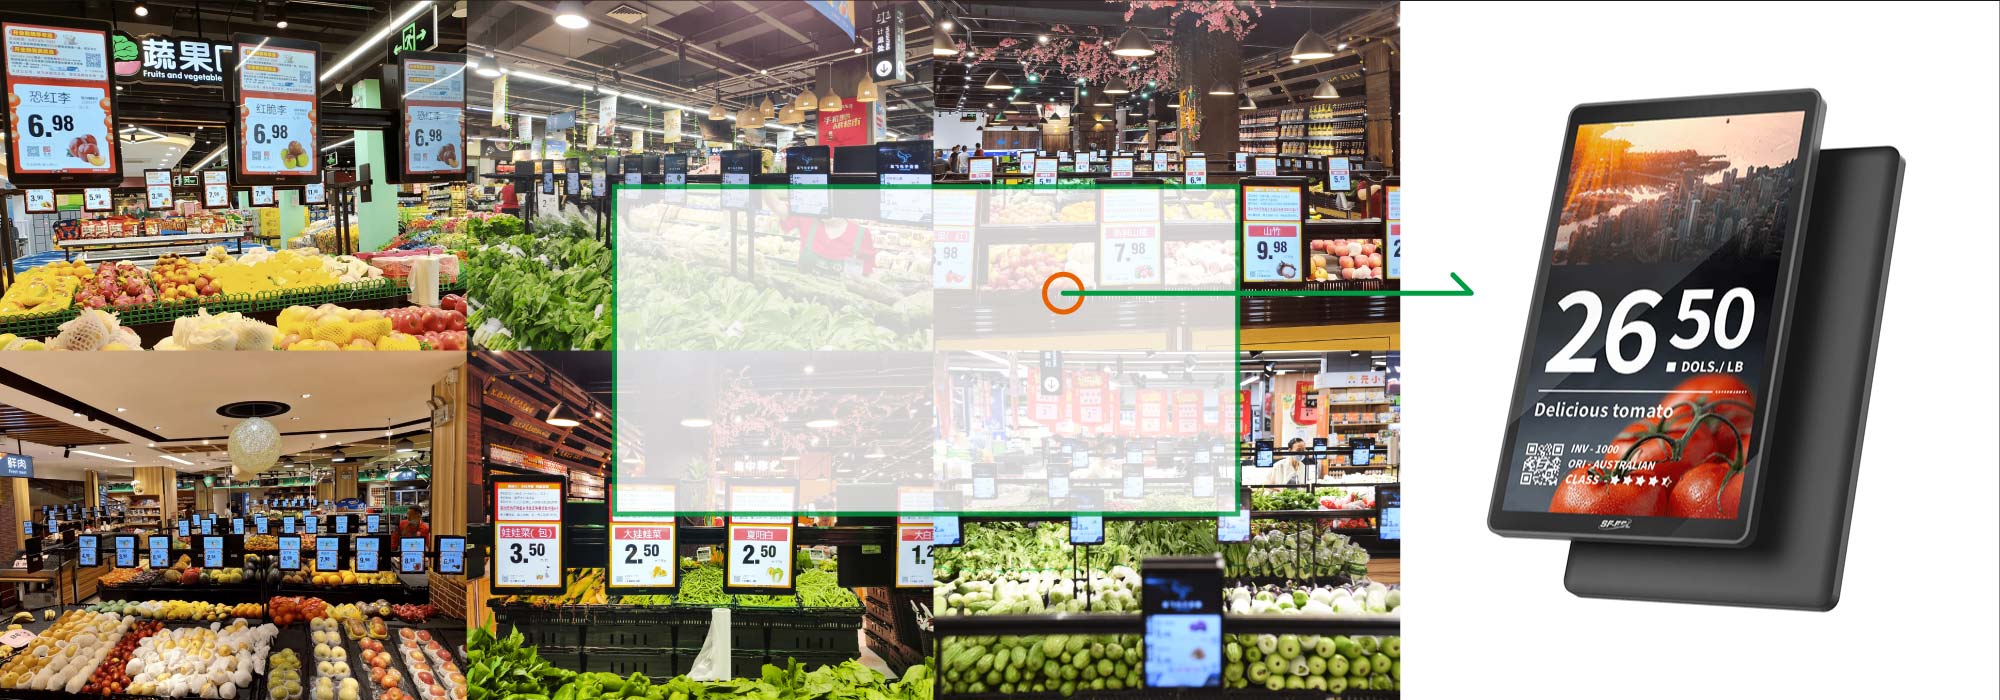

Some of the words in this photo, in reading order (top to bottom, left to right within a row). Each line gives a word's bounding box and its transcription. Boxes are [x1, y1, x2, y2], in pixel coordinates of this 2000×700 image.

[143, 70, 165, 78] Fruits
[167, 71, 182, 80] and
[29, 90, 71, 104] 恐红李
[256, 103, 287, 115] 红脆李
[27, 113, 74, 138] 6.98
[253, 123, 288, 144] 6.98
[414, 128, 442, 147] 6.98
[1264, 227, 1280, 237] 山竹
[1114, 242, 1145, 263] 7.98
[1256, 240, 1287, 260] 9.98
[1544, 288, 1663, 375] 26
[1669, 286, 1755, 350] 50
[1727, 361, 1744, 373] LB
[1534, 402, 1608, 418] Delicious
[1613, 403, 1674, 419] tomato
[1571, 444, 1588, 454] INV
[1595, 444, 1620, 455] 1000
[7, 457, 27, 469] 鲜肉
[1568, 459, 1586, 469] ORI
[1593, 459, 1656, 471] AUSTRALIAN
[1565, 474, 1599, 485] CLASS
[746, 530, 773, 540] 夏阳白
[914, 531, 934, 540] 大白
[510, 543, 545, 564] 3.50
[625, 543, 659, 564] 2.50
[742, 545, 776, 565] 2.50
